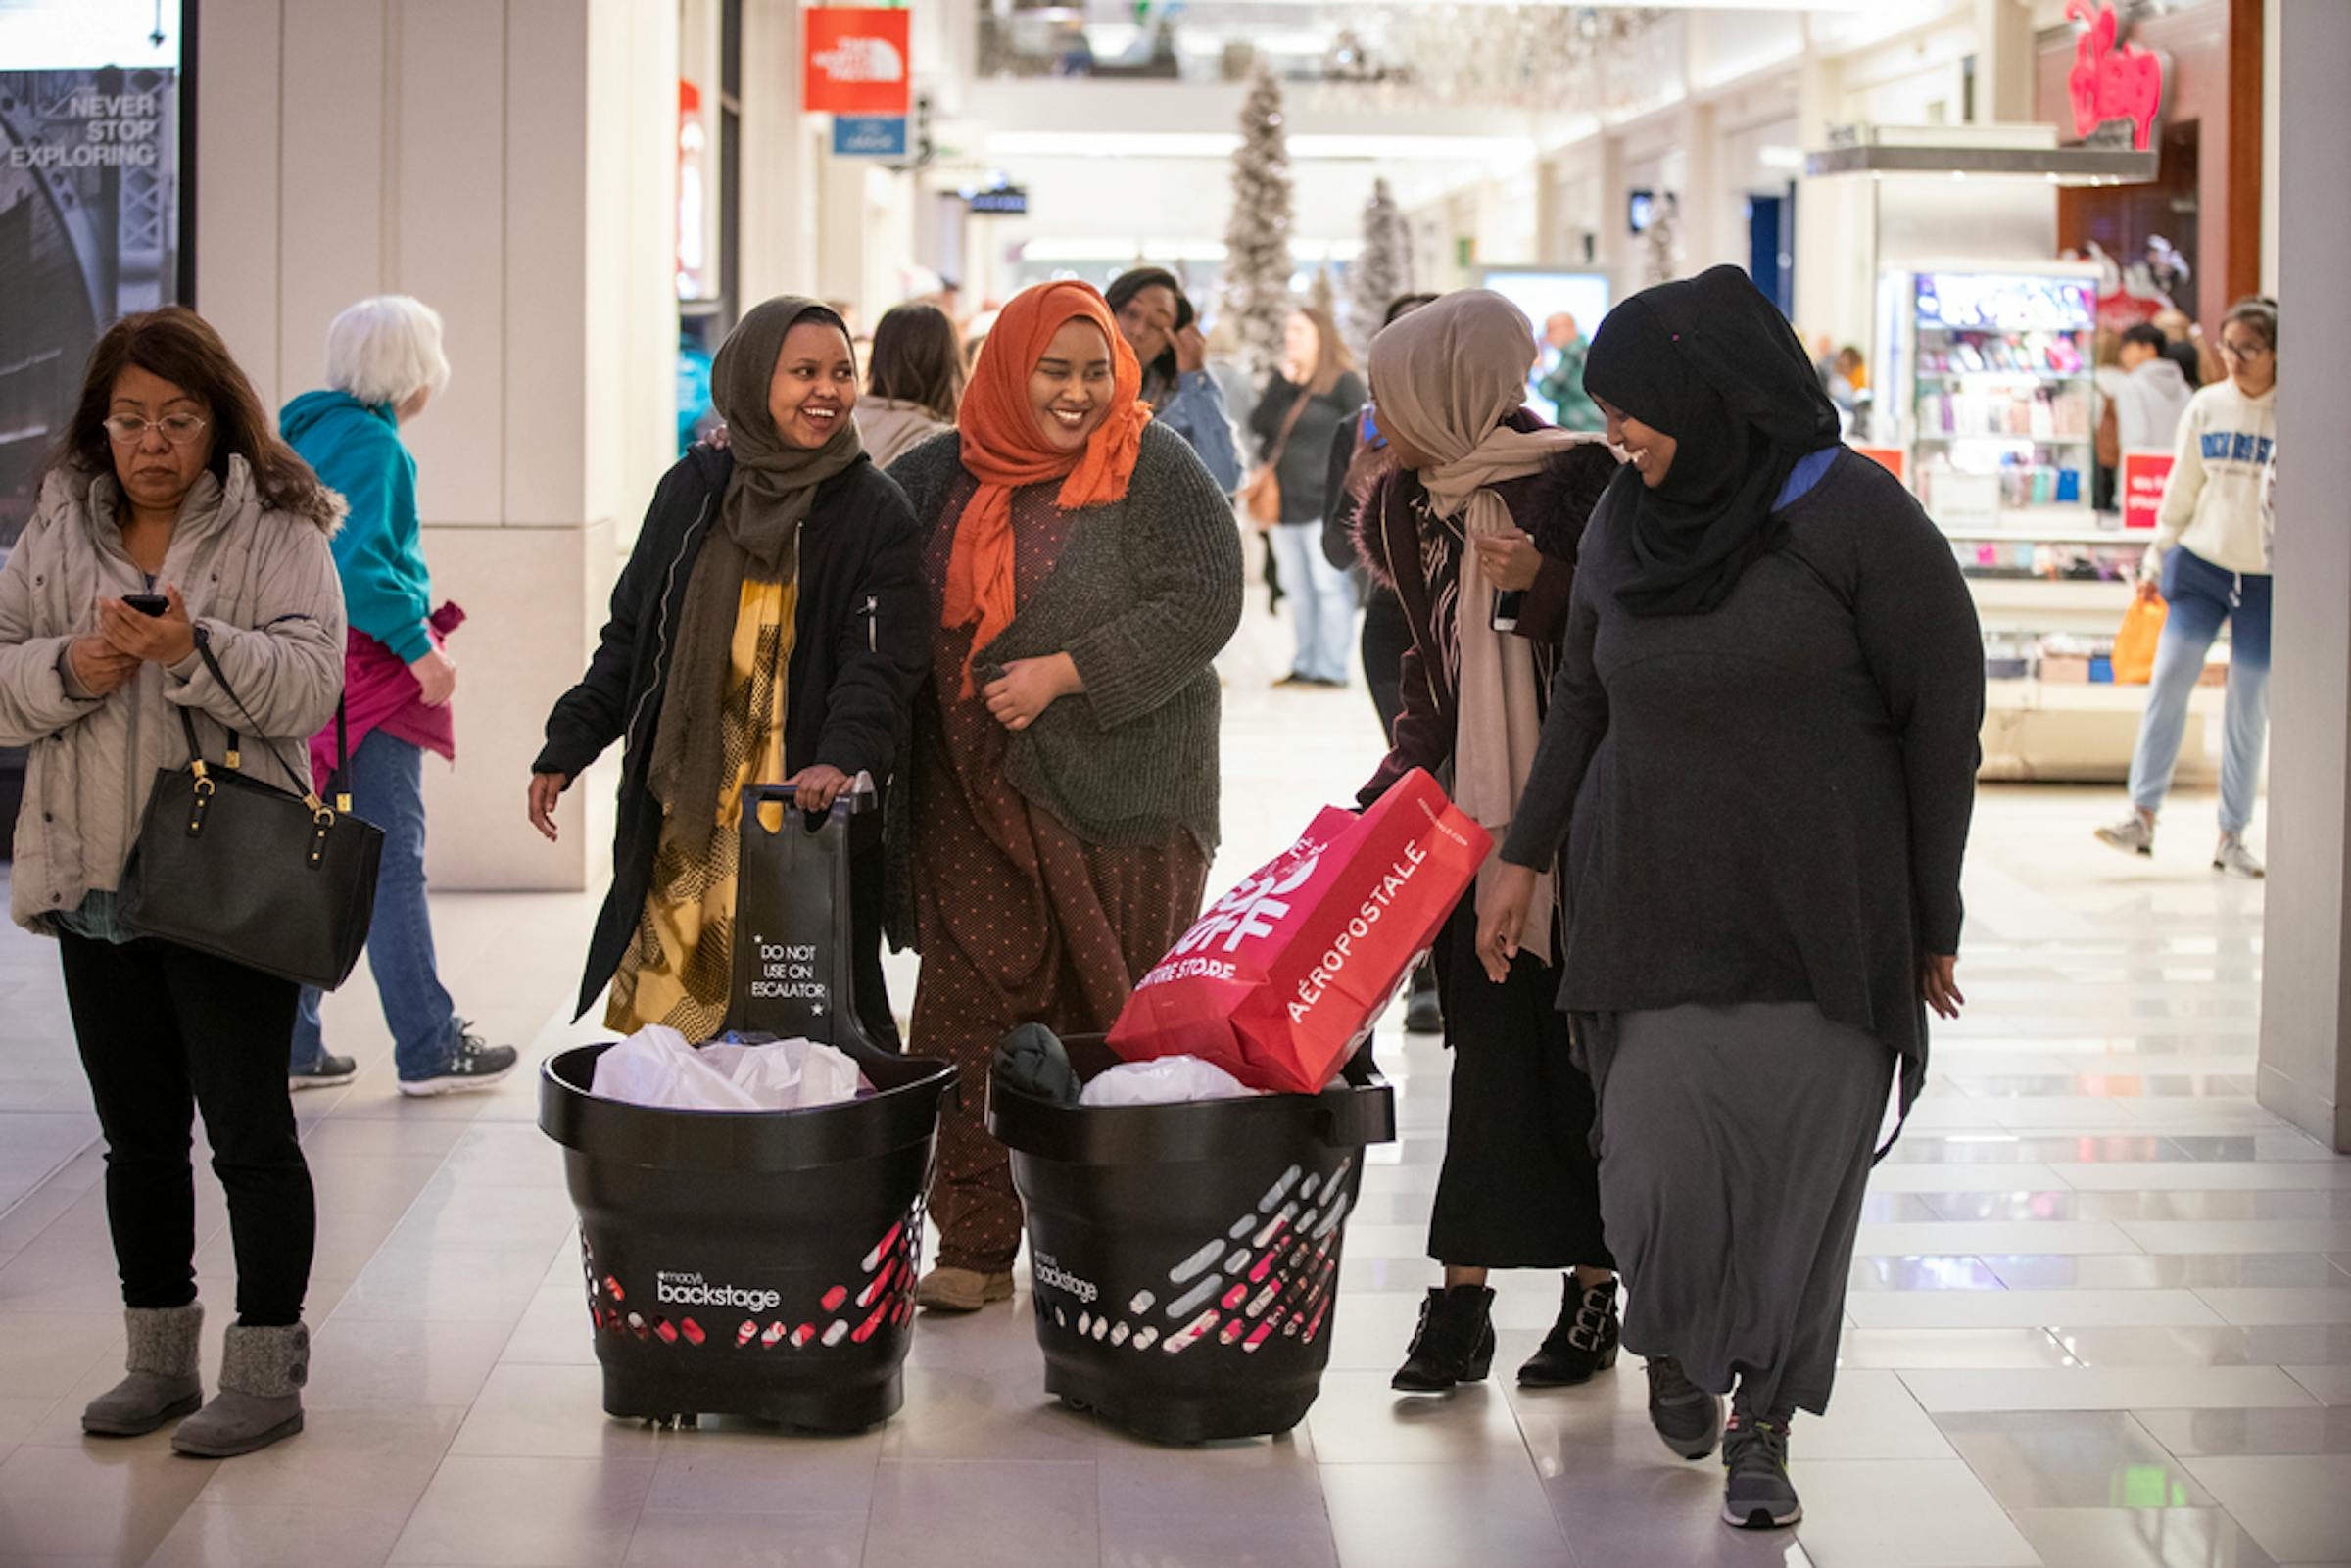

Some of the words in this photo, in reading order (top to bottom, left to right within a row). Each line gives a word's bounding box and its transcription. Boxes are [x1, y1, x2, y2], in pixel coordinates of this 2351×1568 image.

[70, 95, 154, 118] NEVER
[87, 119, 155, 142] STOP
[10, 144, 156, 167] EXPLORING
[761, 944, 784, 960] DO
[787, 946, 817, 961] NOT
[763, 963, 786, 978] USE
[789, 964, 813, 978] ON
[1176, 957, 1236, 979] STORE
[751, 981, 825, 998] ESCALATOR
[1035, 1262, 1098, 1304] backstage
[657, 1279, 781, 1312] backstage
